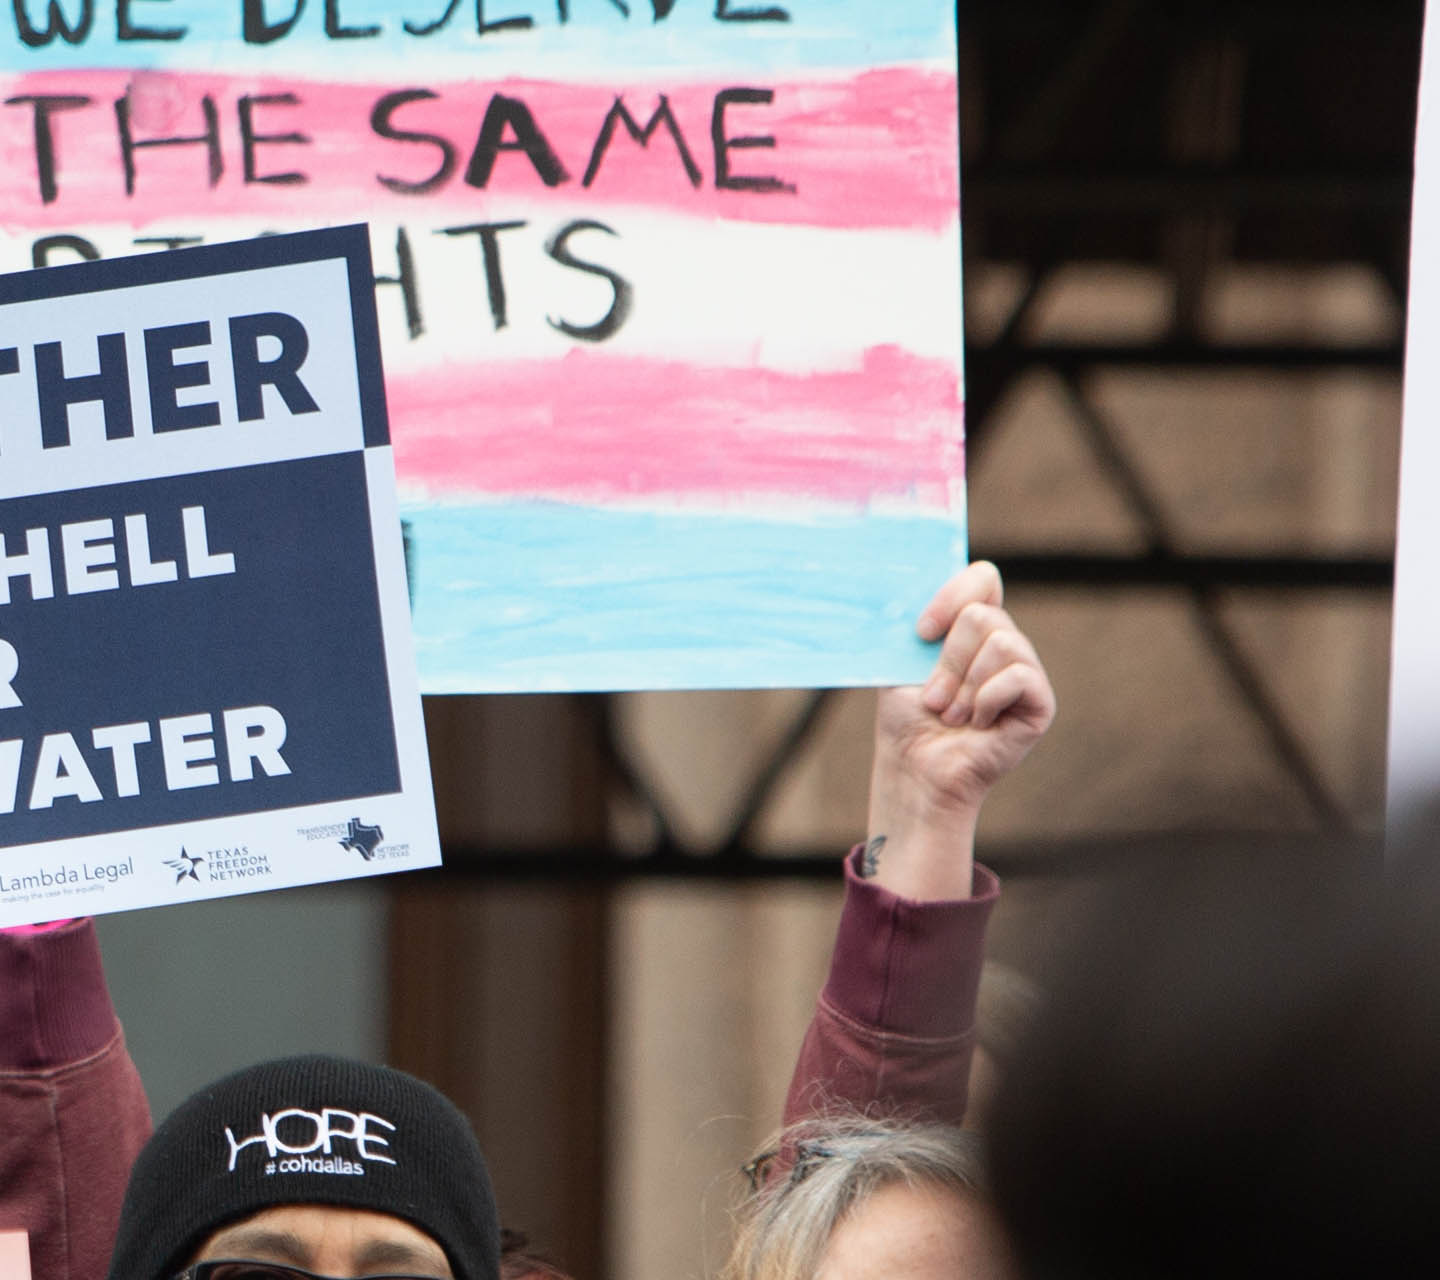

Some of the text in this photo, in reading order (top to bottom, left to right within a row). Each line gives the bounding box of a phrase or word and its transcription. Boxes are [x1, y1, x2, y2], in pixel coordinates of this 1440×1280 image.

[4, 86, 797, 204] THE SAME
[31, 217, 634, 343] HTS
[207, 846, 249, 860] TEXAS
[208, 855, 268, 871] FREEDOM
[0, 856, 134, 893] Lambda Legal
[209, 866, 273, 882] NETWORK
[225, 1108, 398, 1172] HOPE
